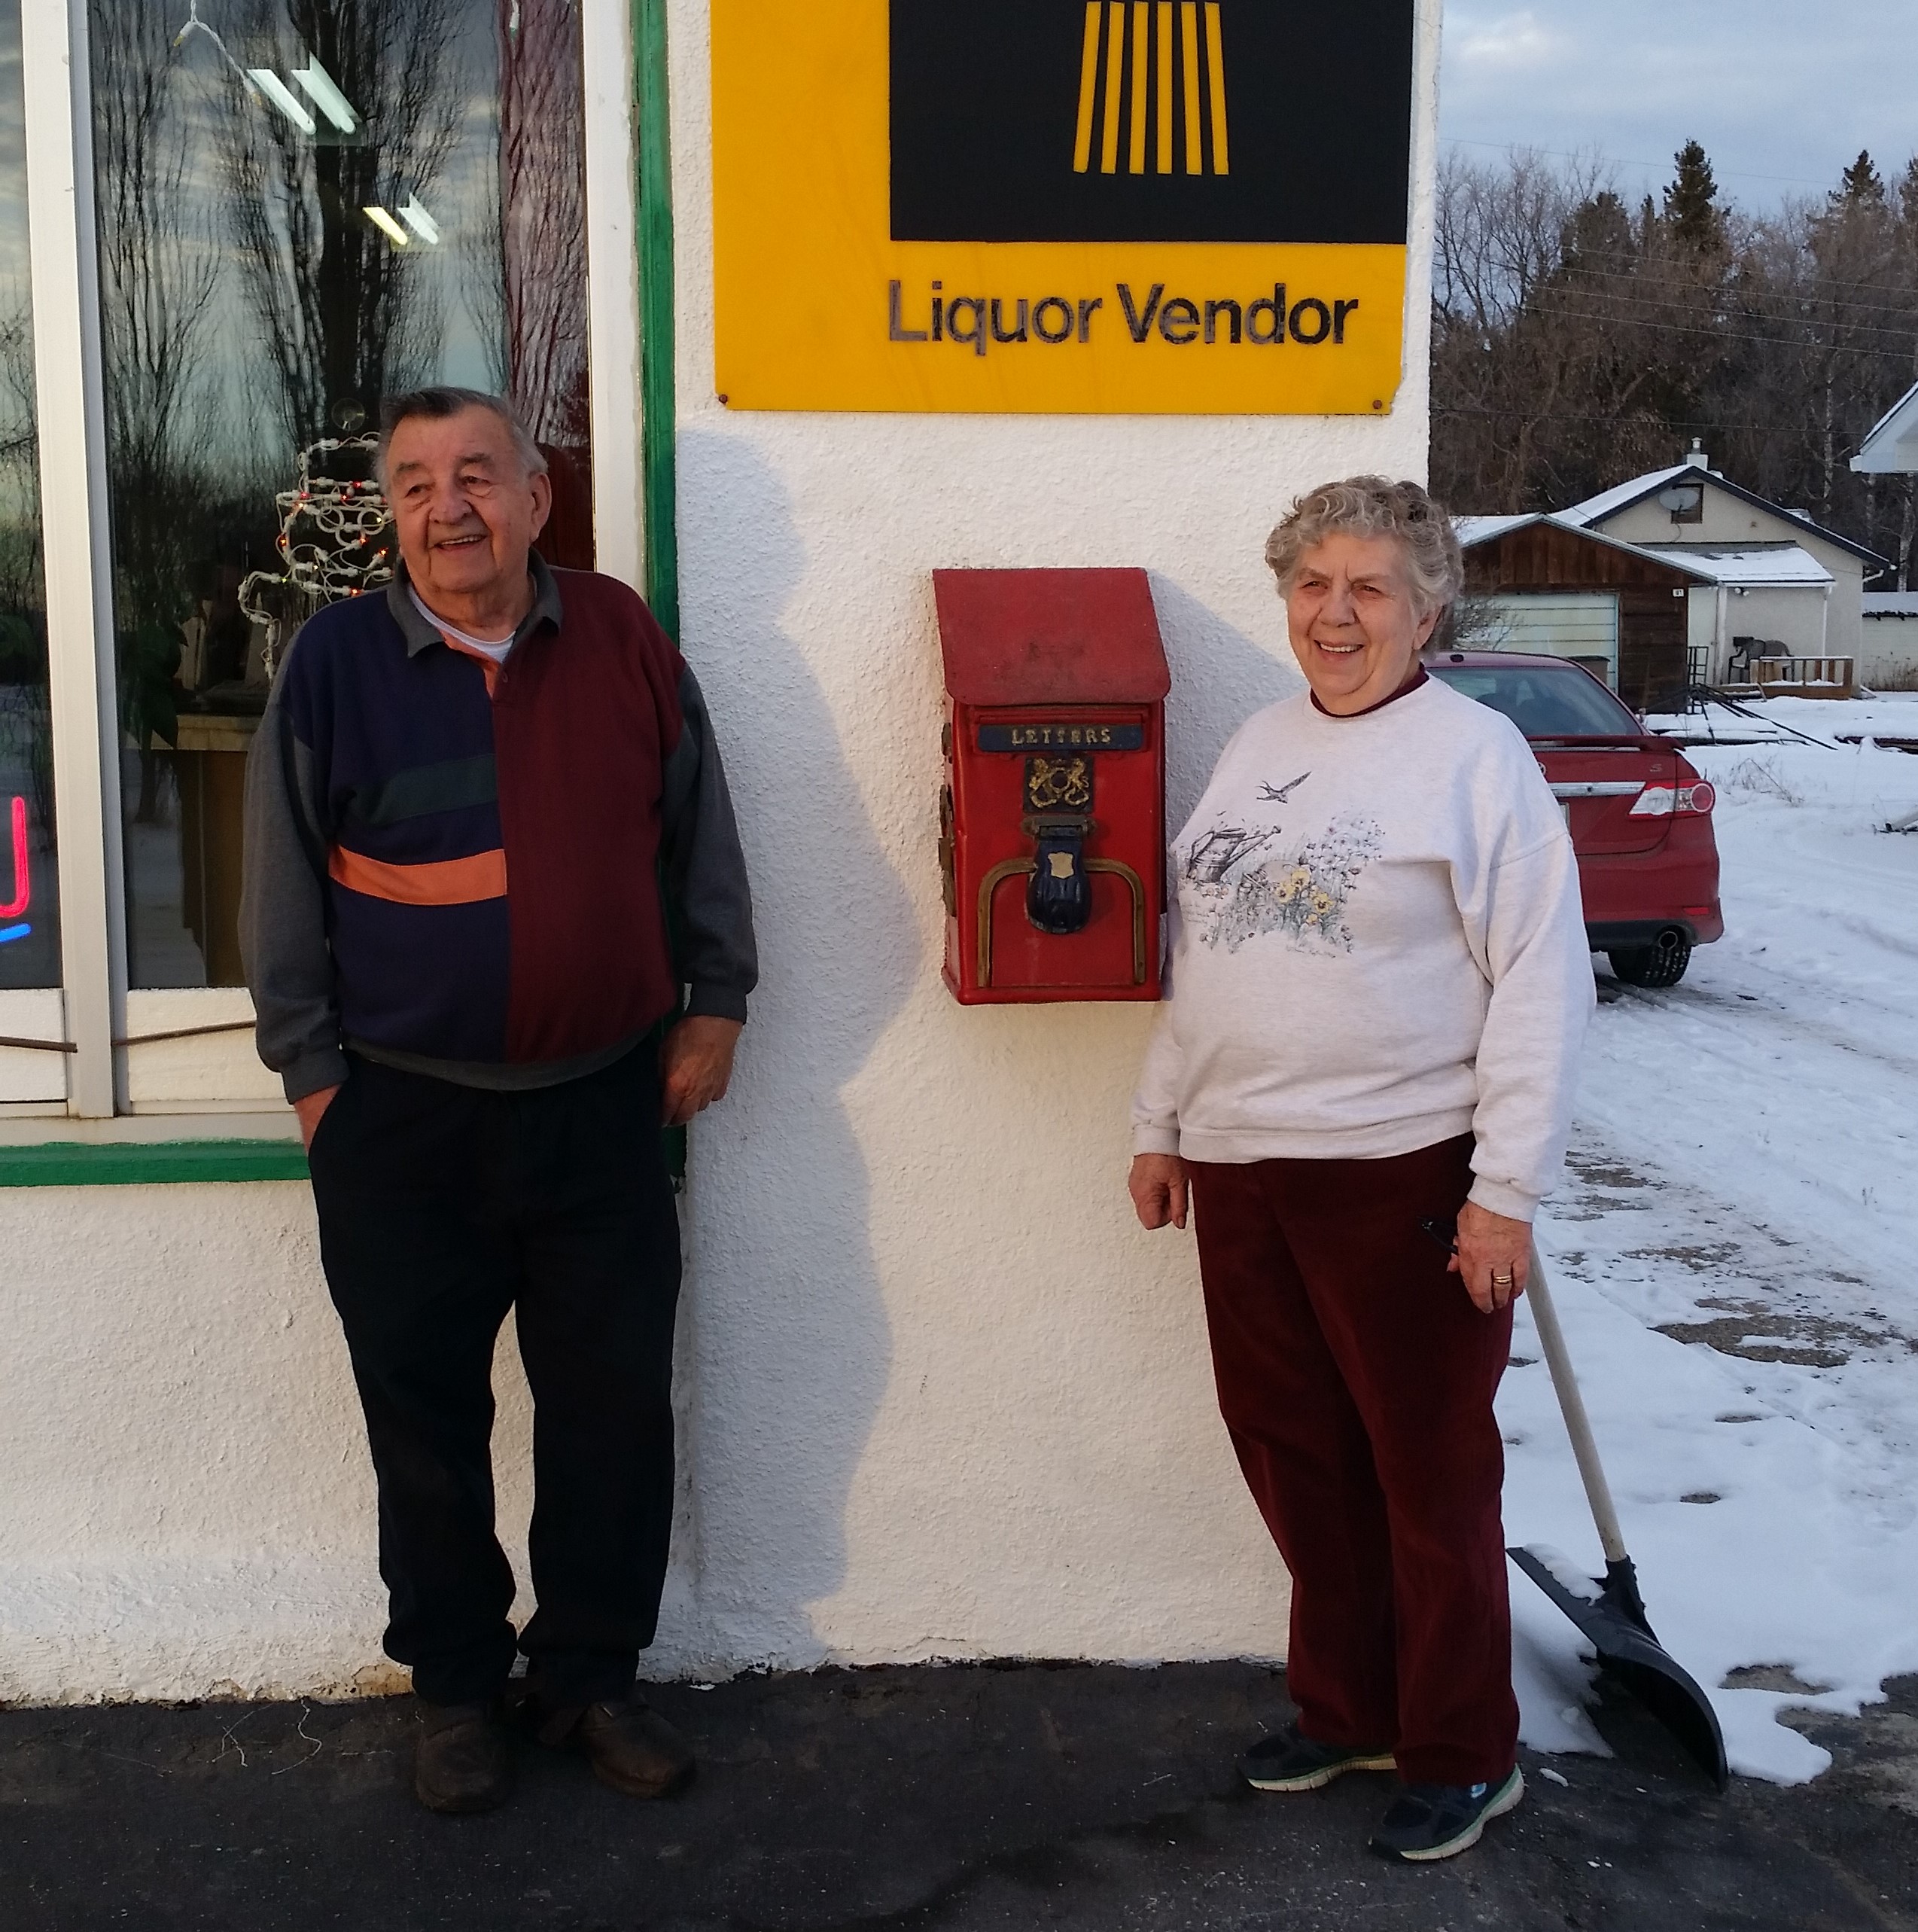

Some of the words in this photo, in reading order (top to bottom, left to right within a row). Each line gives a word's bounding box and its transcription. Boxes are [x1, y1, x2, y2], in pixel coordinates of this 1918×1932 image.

[889, 279, 1103, 356] Liquor
[1116, 282, 1359, 344] Vendor
[1011, 727, 1111, 745] LETTERS
[1649, 763, 1662, 772] S
